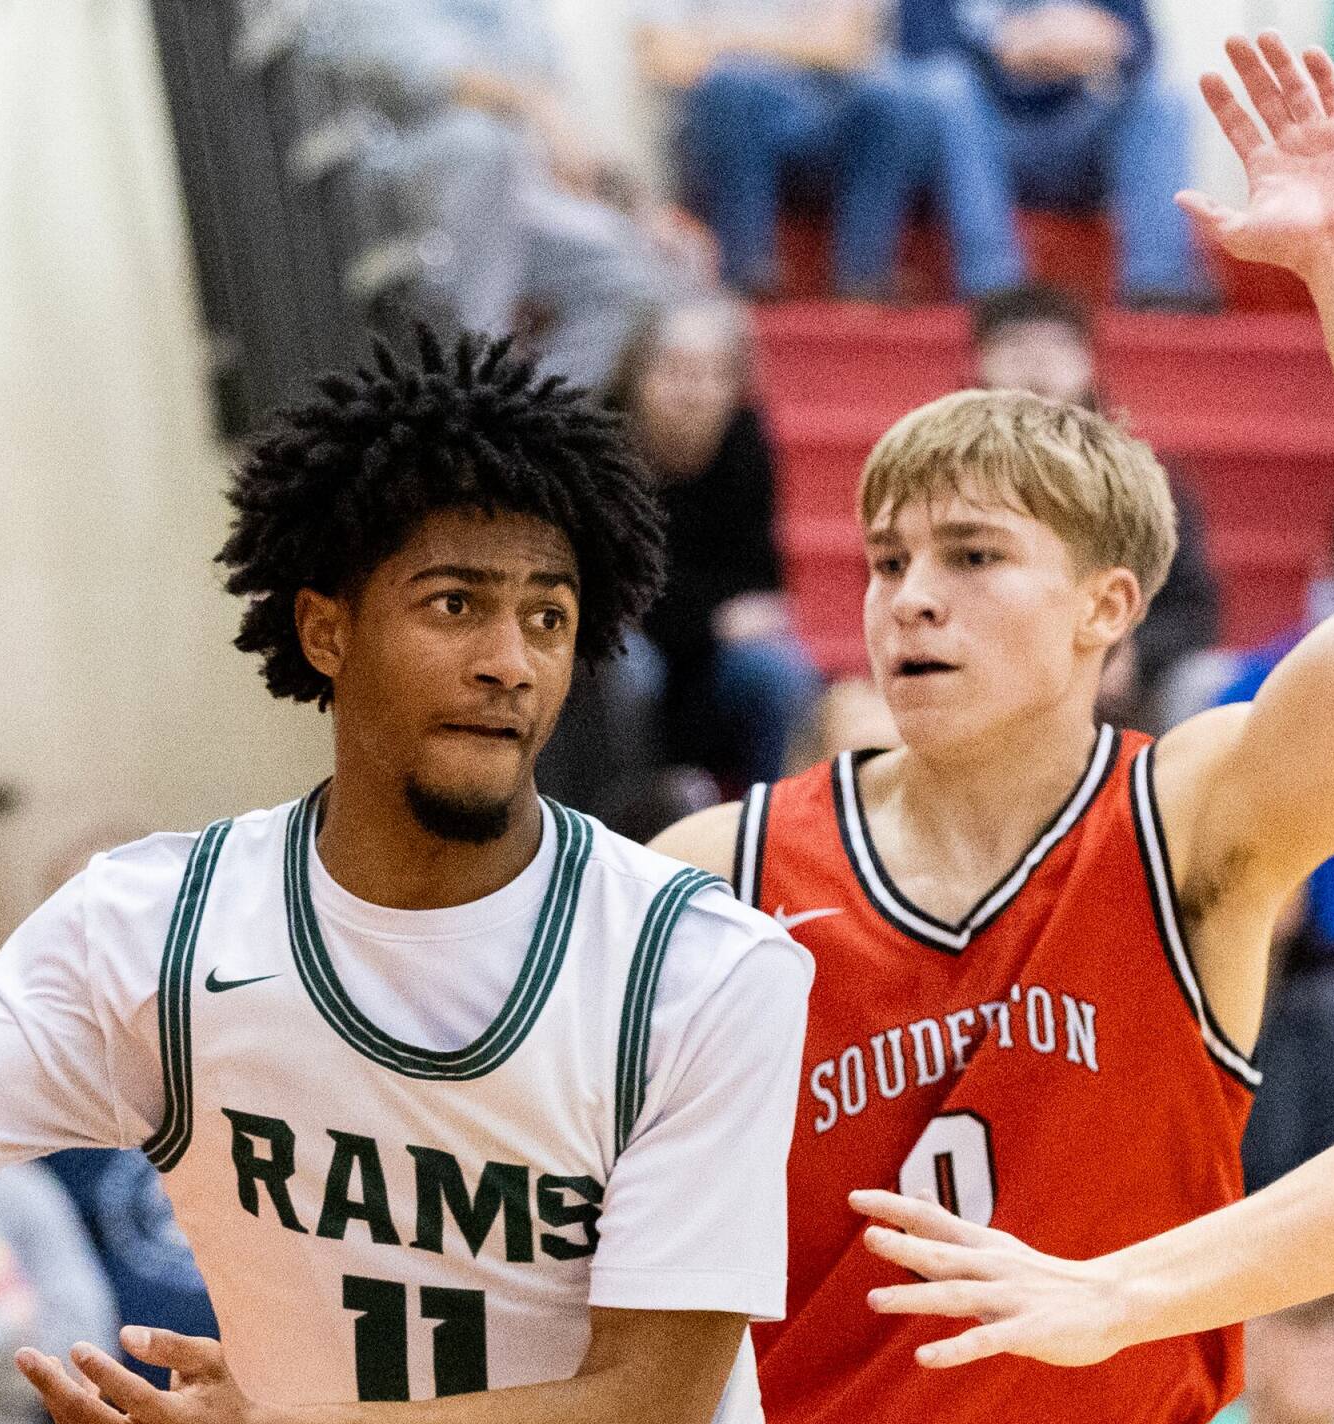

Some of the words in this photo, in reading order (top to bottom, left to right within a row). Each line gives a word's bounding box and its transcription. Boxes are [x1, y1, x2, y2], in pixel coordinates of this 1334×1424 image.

[221, 1107, 605, 1263] RAMS
[898, 1108, 999, 1231] 0
[342, 1274, 489, 1402] 11
